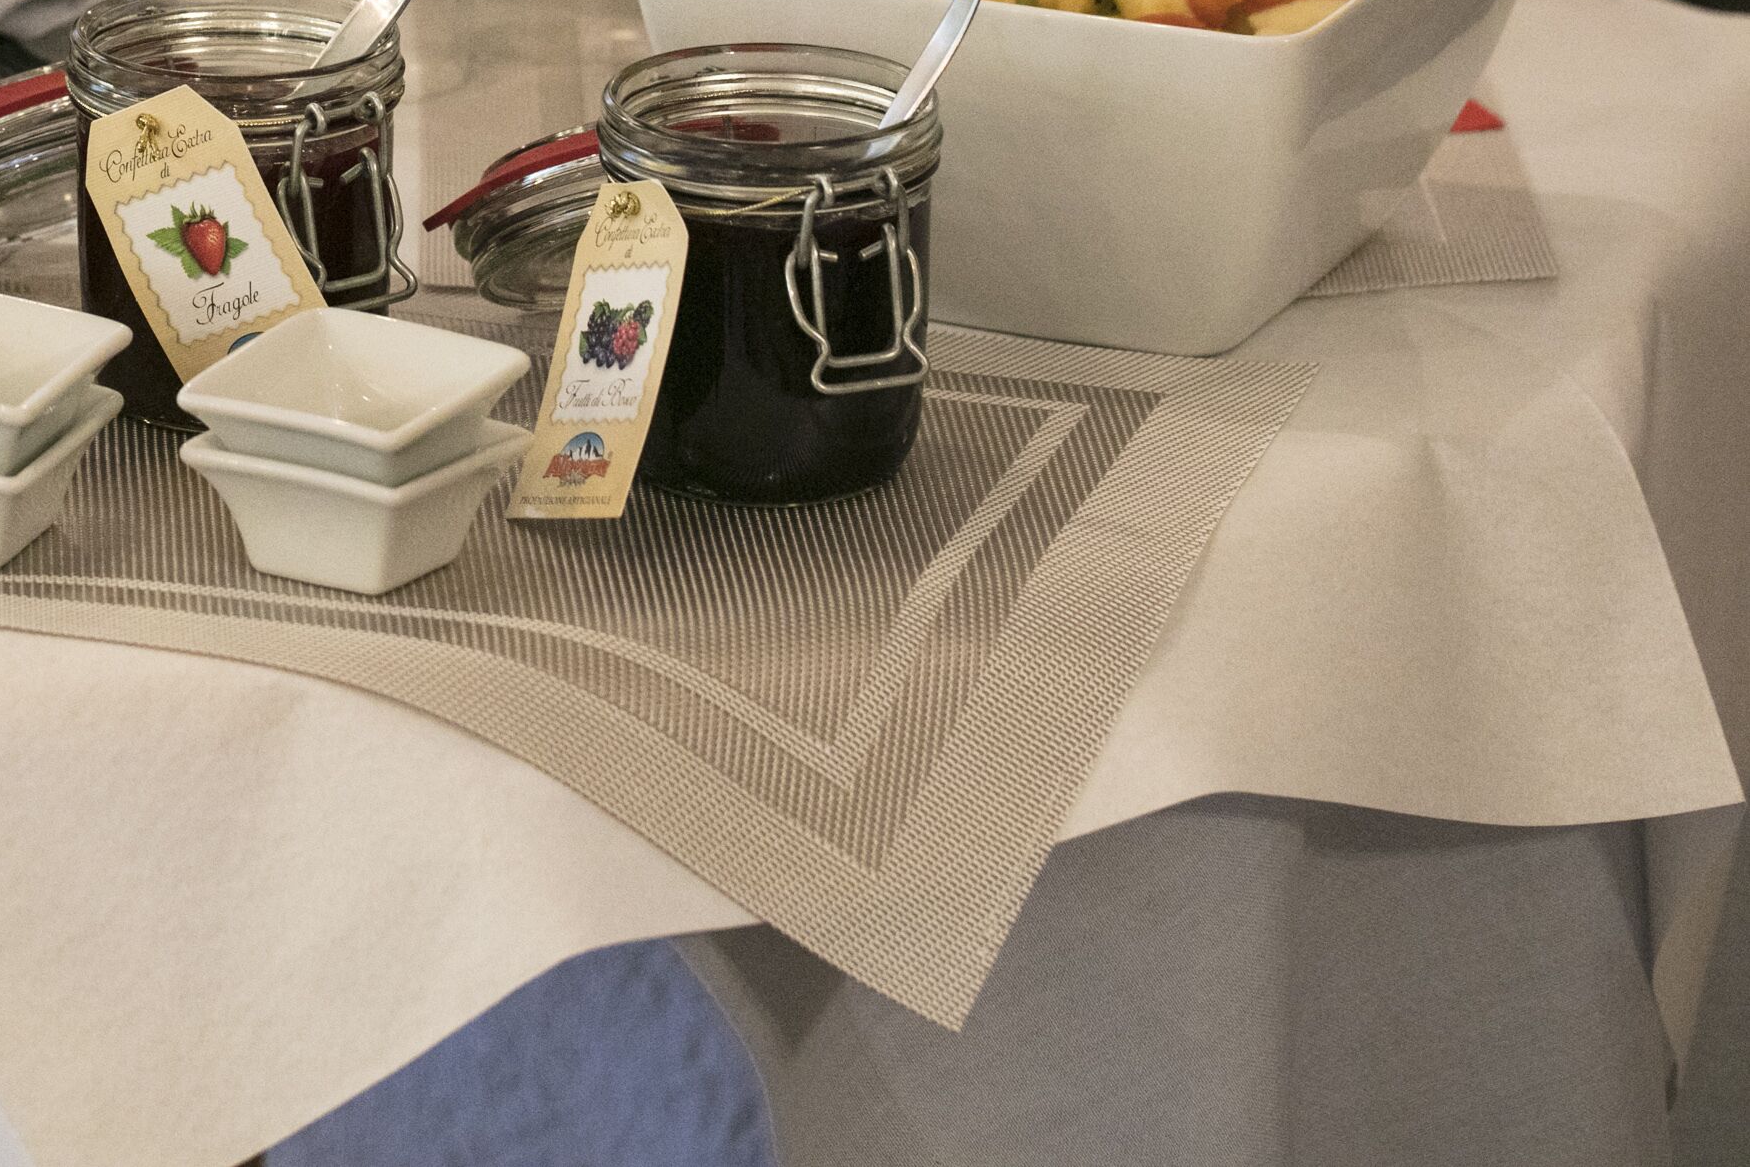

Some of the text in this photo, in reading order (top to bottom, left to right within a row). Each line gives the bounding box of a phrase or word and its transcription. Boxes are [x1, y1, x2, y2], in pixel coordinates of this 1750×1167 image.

[167, 123, 213, 158] Extra
[159, 161, 171, 179] di
[192, 280, 260, 325] Fragole
